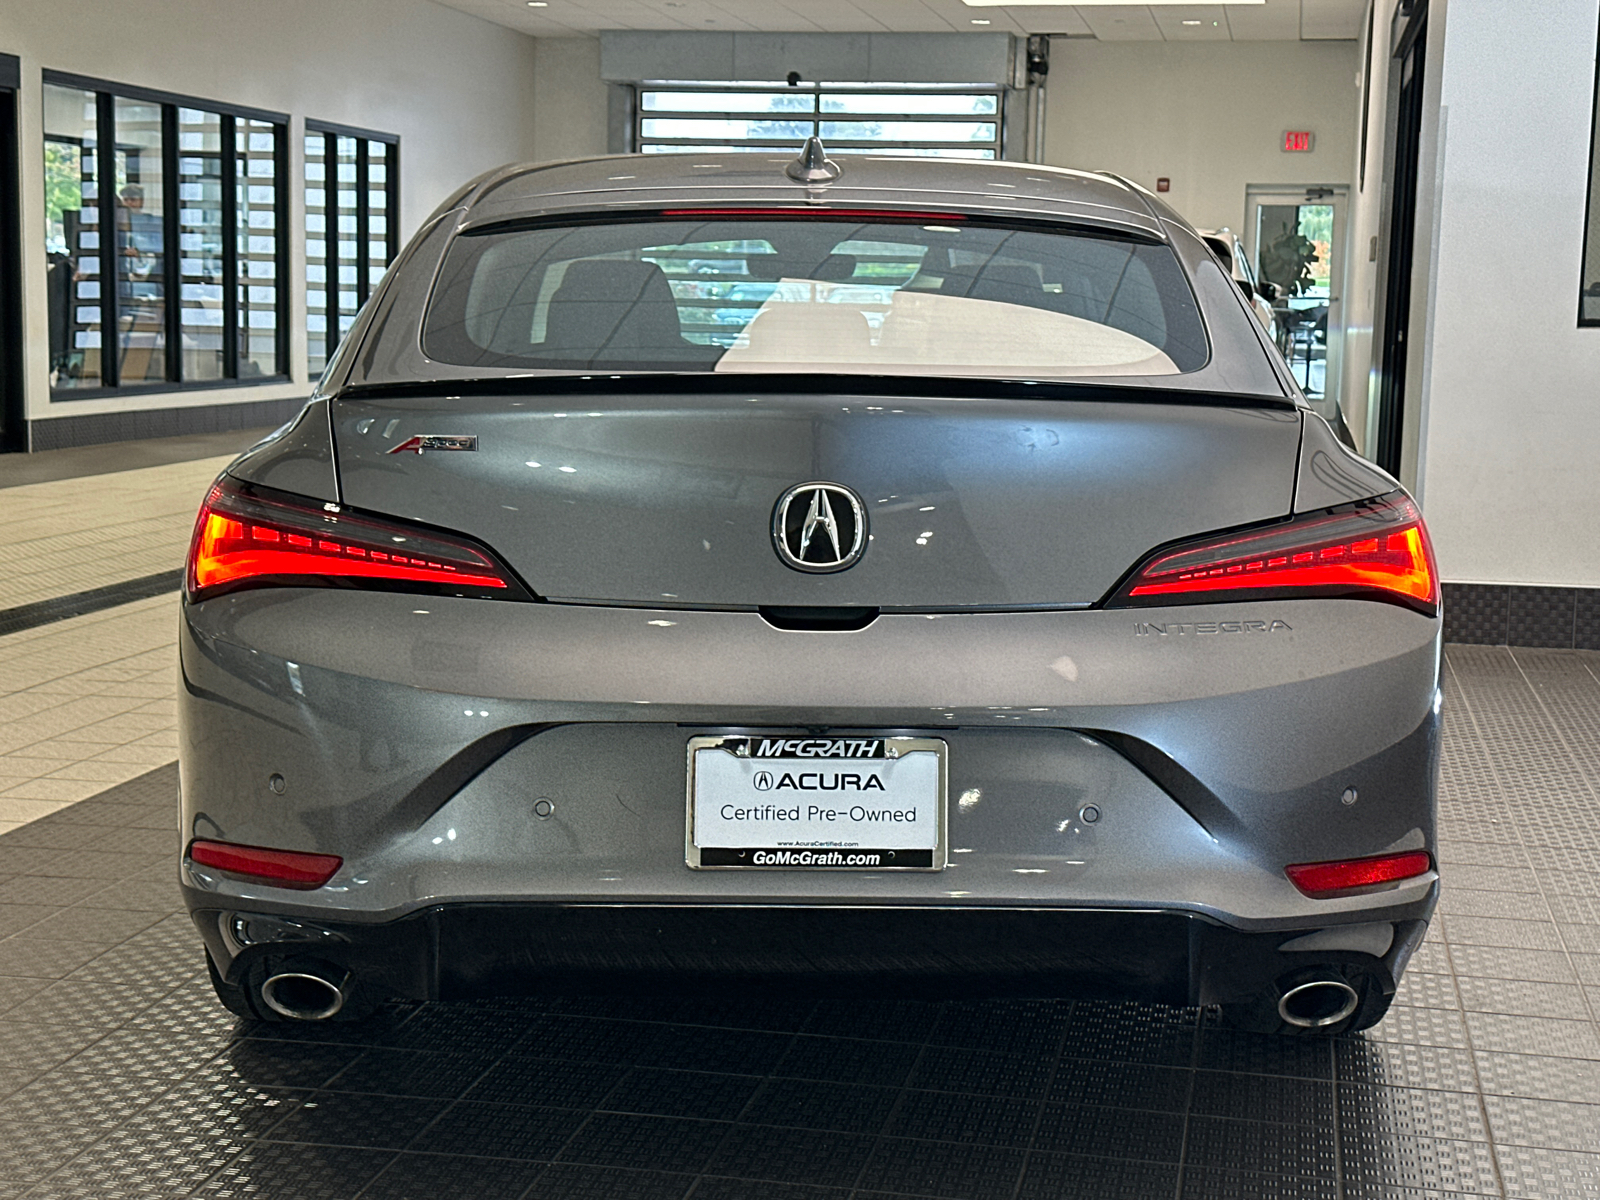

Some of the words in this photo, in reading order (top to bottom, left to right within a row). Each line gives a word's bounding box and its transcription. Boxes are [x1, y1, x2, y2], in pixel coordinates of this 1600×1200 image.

[1285, 131, 1309, 151] EXIT
[1134, 620, 1293, 636] INTEGRA
[775, 773, 886, 791] ACURA
[720, 804, 800, 821] Certified
[808, 806, 916, 822] Pre-Owned
[753, 851, 881, 866] GoMcGrath.com
